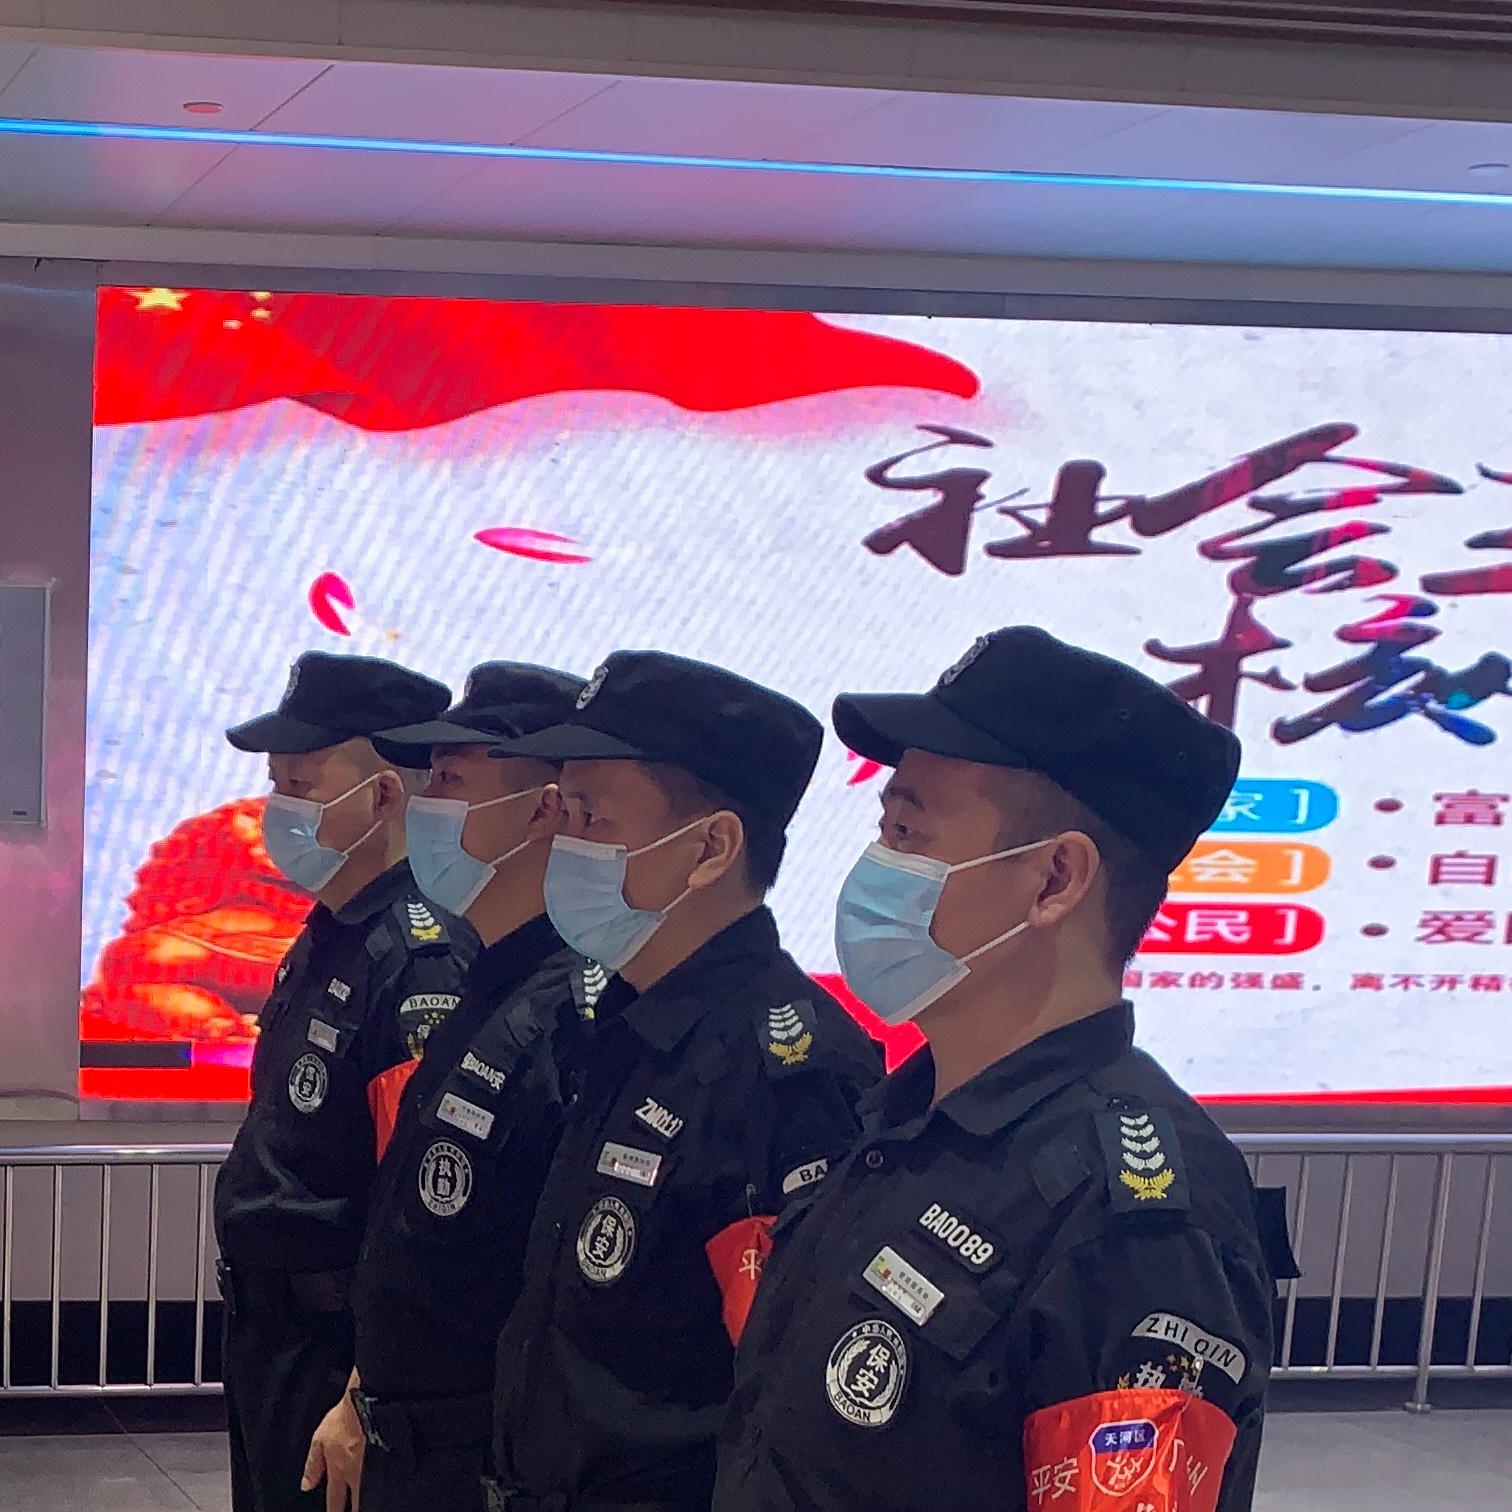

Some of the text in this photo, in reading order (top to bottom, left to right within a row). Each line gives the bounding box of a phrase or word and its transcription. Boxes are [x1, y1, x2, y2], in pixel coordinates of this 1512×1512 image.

[861, 421, 1512, 597] 社会
[1432, 788, 1511, 827] 富
[1415, 910, 1512, 945] 爱
[592, 1214, 618, 1259] 保安
[919, 1203, 994, 1265] BA0089
[850, 1342, 891, 1397] 保安
[834, 1391, 872, 1423] BAOAN
[1104, 1428, 1146, 1446] 天河区
[1031, 1456, 1080, 1505] 平安
